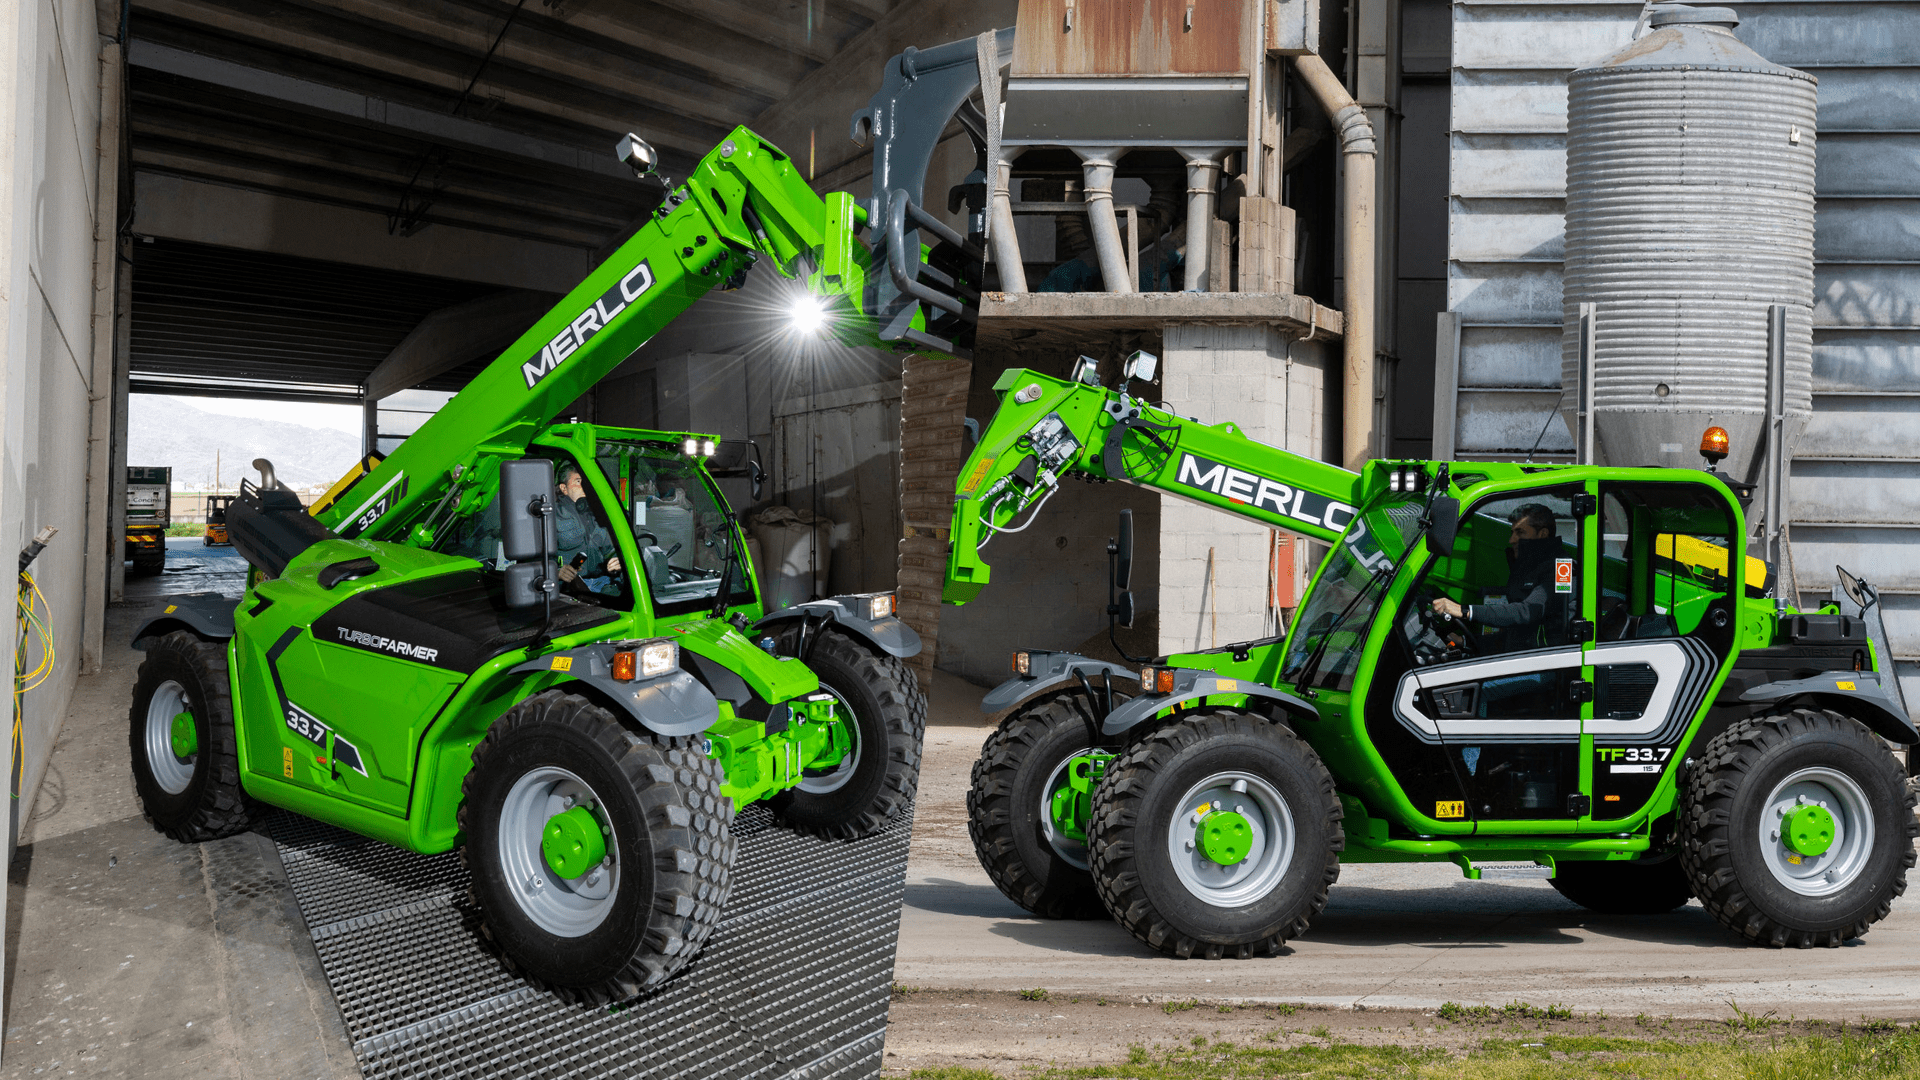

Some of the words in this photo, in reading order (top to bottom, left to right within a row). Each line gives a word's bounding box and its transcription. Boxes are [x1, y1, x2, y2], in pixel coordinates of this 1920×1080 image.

[522, 263, 652, 388] MERLO
[1178, 453, 1361, 533] MERLO
[358, 498, 386, 531] 33.7
[337, 626, 438, 662] TURBOFARMER
[286, 710, 325, 742] 33.7
[1595, 748, 1672, 762] TF33.7
